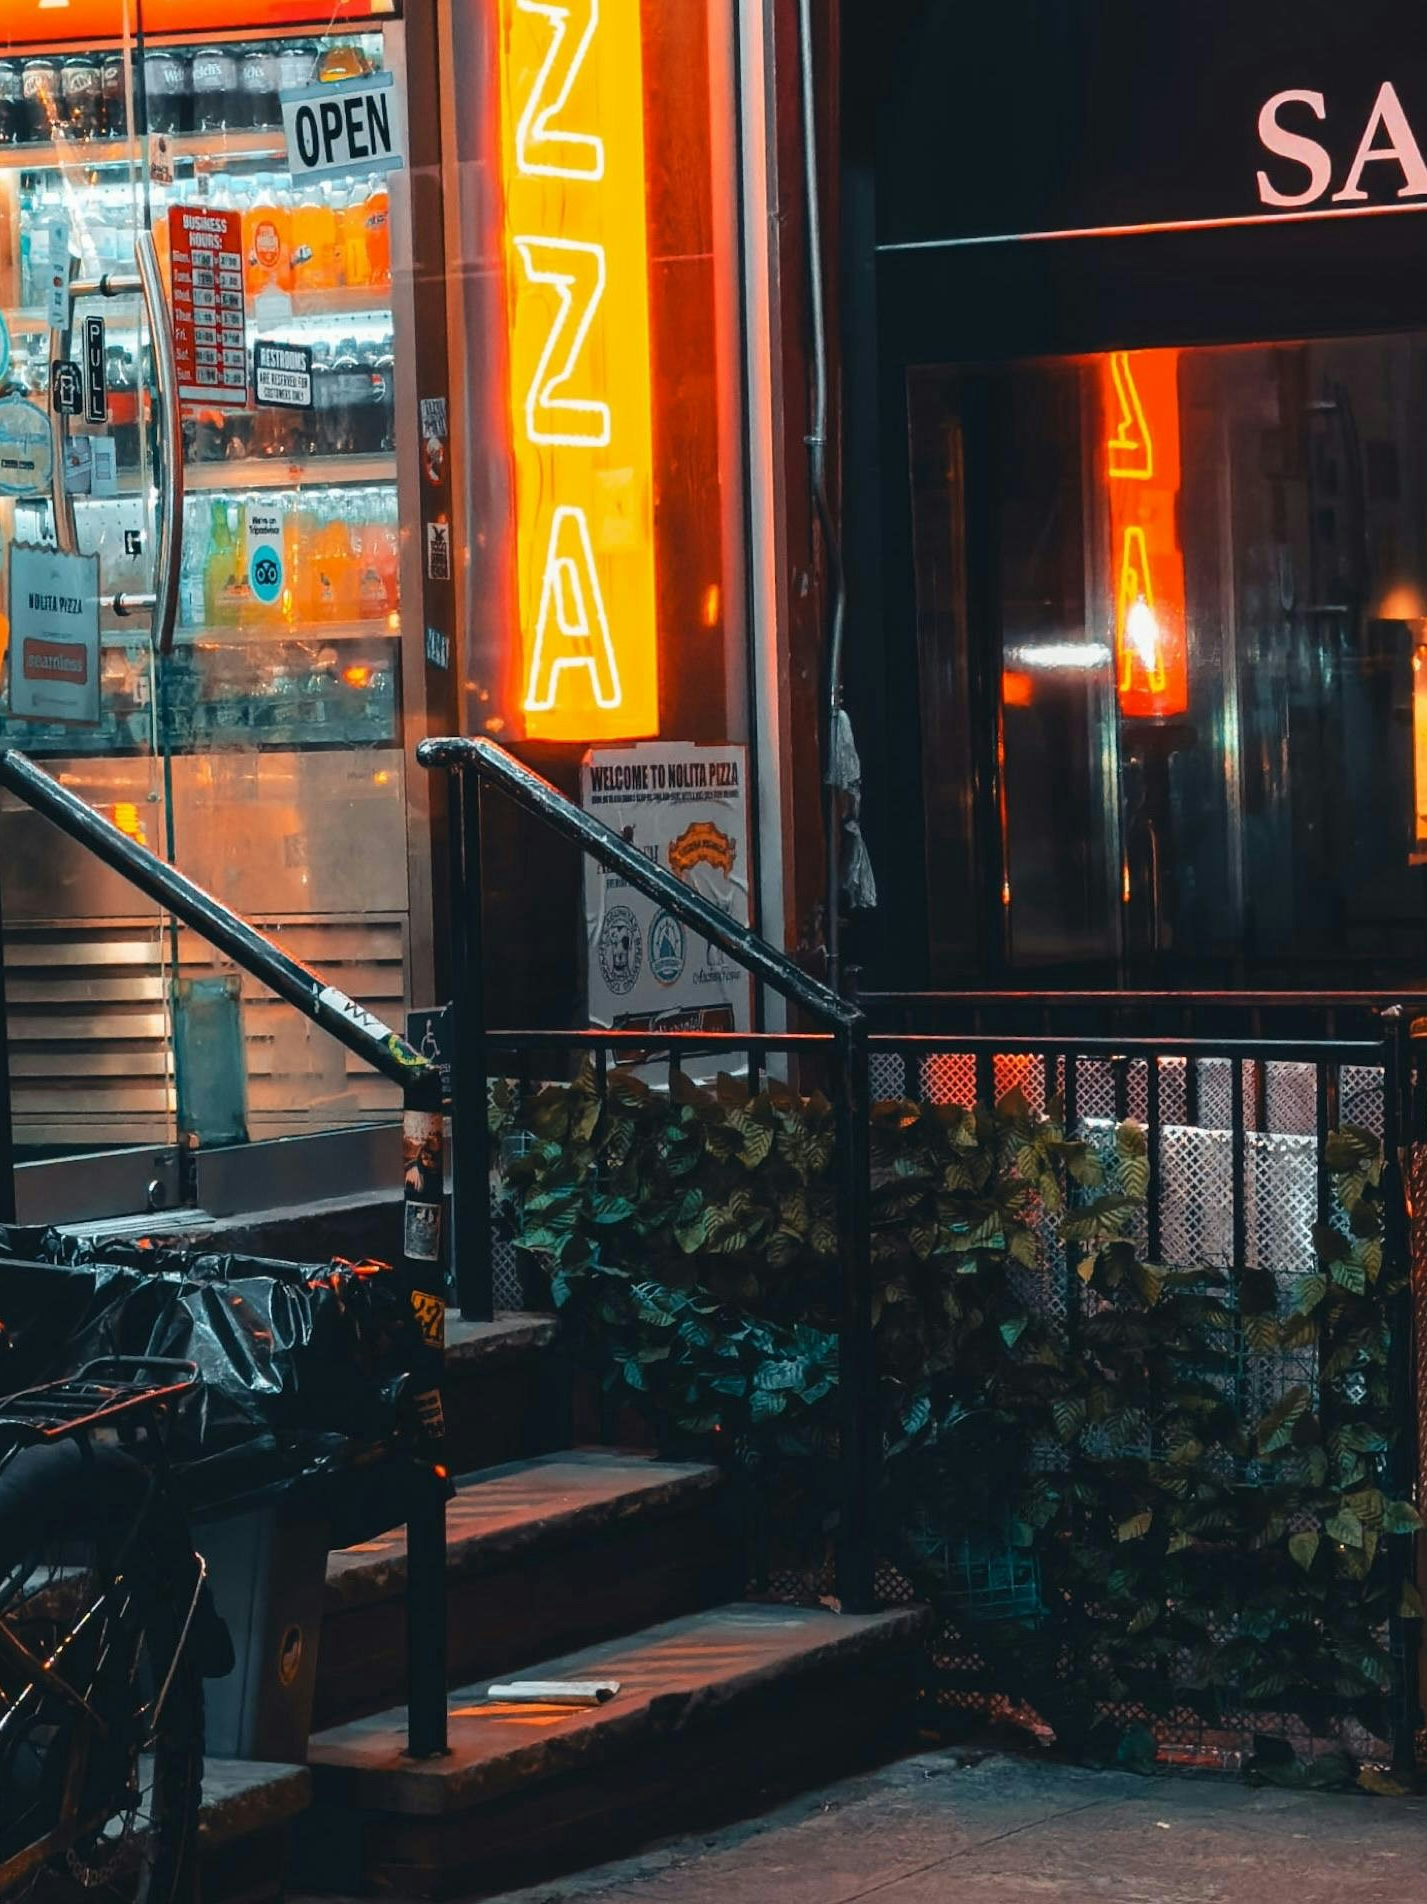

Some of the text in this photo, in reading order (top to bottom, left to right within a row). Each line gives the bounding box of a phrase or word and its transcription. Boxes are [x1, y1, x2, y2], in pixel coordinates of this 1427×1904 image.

[294, 92, 392, 168] OPEN
[182, 214, 228, 234] BUSINESS
[89, 324, 103, 415] PULL
[259, 347, 307, 372] RESTROOMS
[271, 372, 298, 387] RESERVED
[28, 593, 83, 615] NOLITA PIZZA
[590, 761, 740, 791] WELCOME TO NOLITA PIZZA
